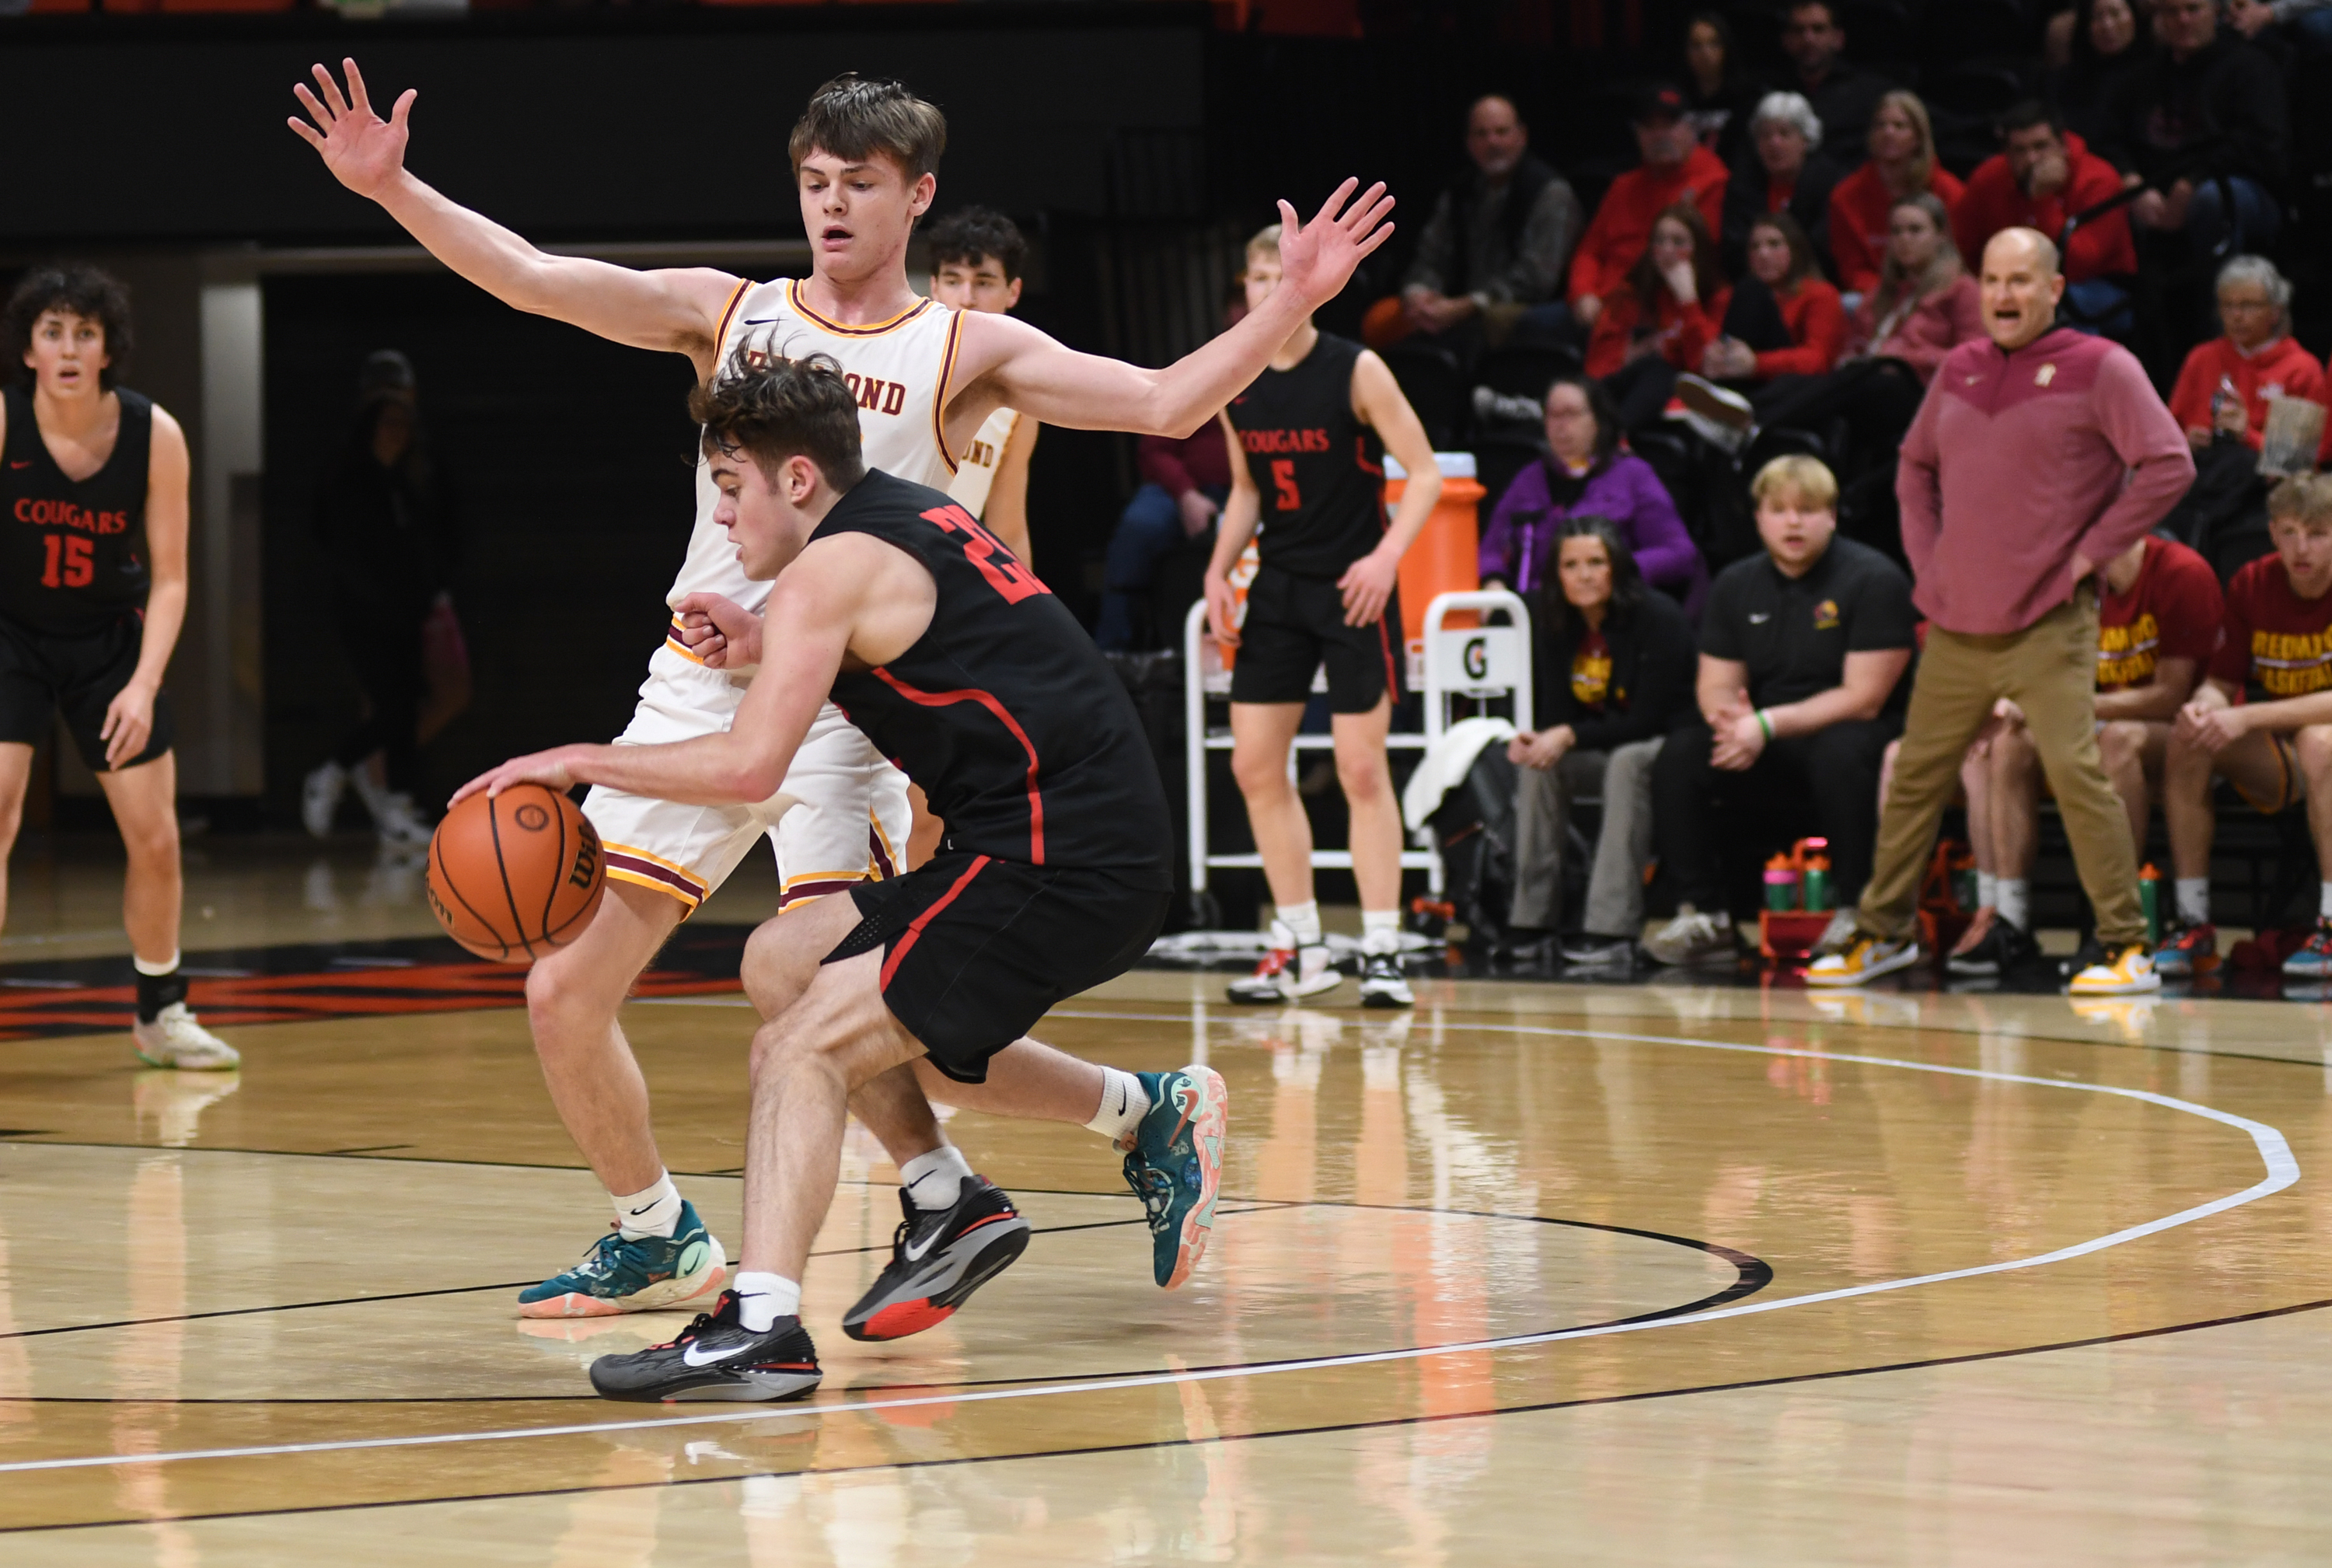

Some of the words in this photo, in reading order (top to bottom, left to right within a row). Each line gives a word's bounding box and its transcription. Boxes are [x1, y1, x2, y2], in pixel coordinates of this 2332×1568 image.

[1271, 459, 1302, 511] 5
[14, 498, 127, 534] COUGARS
[40, 533, 94, 588] 15
[1464, 637, 1486, 681] G
